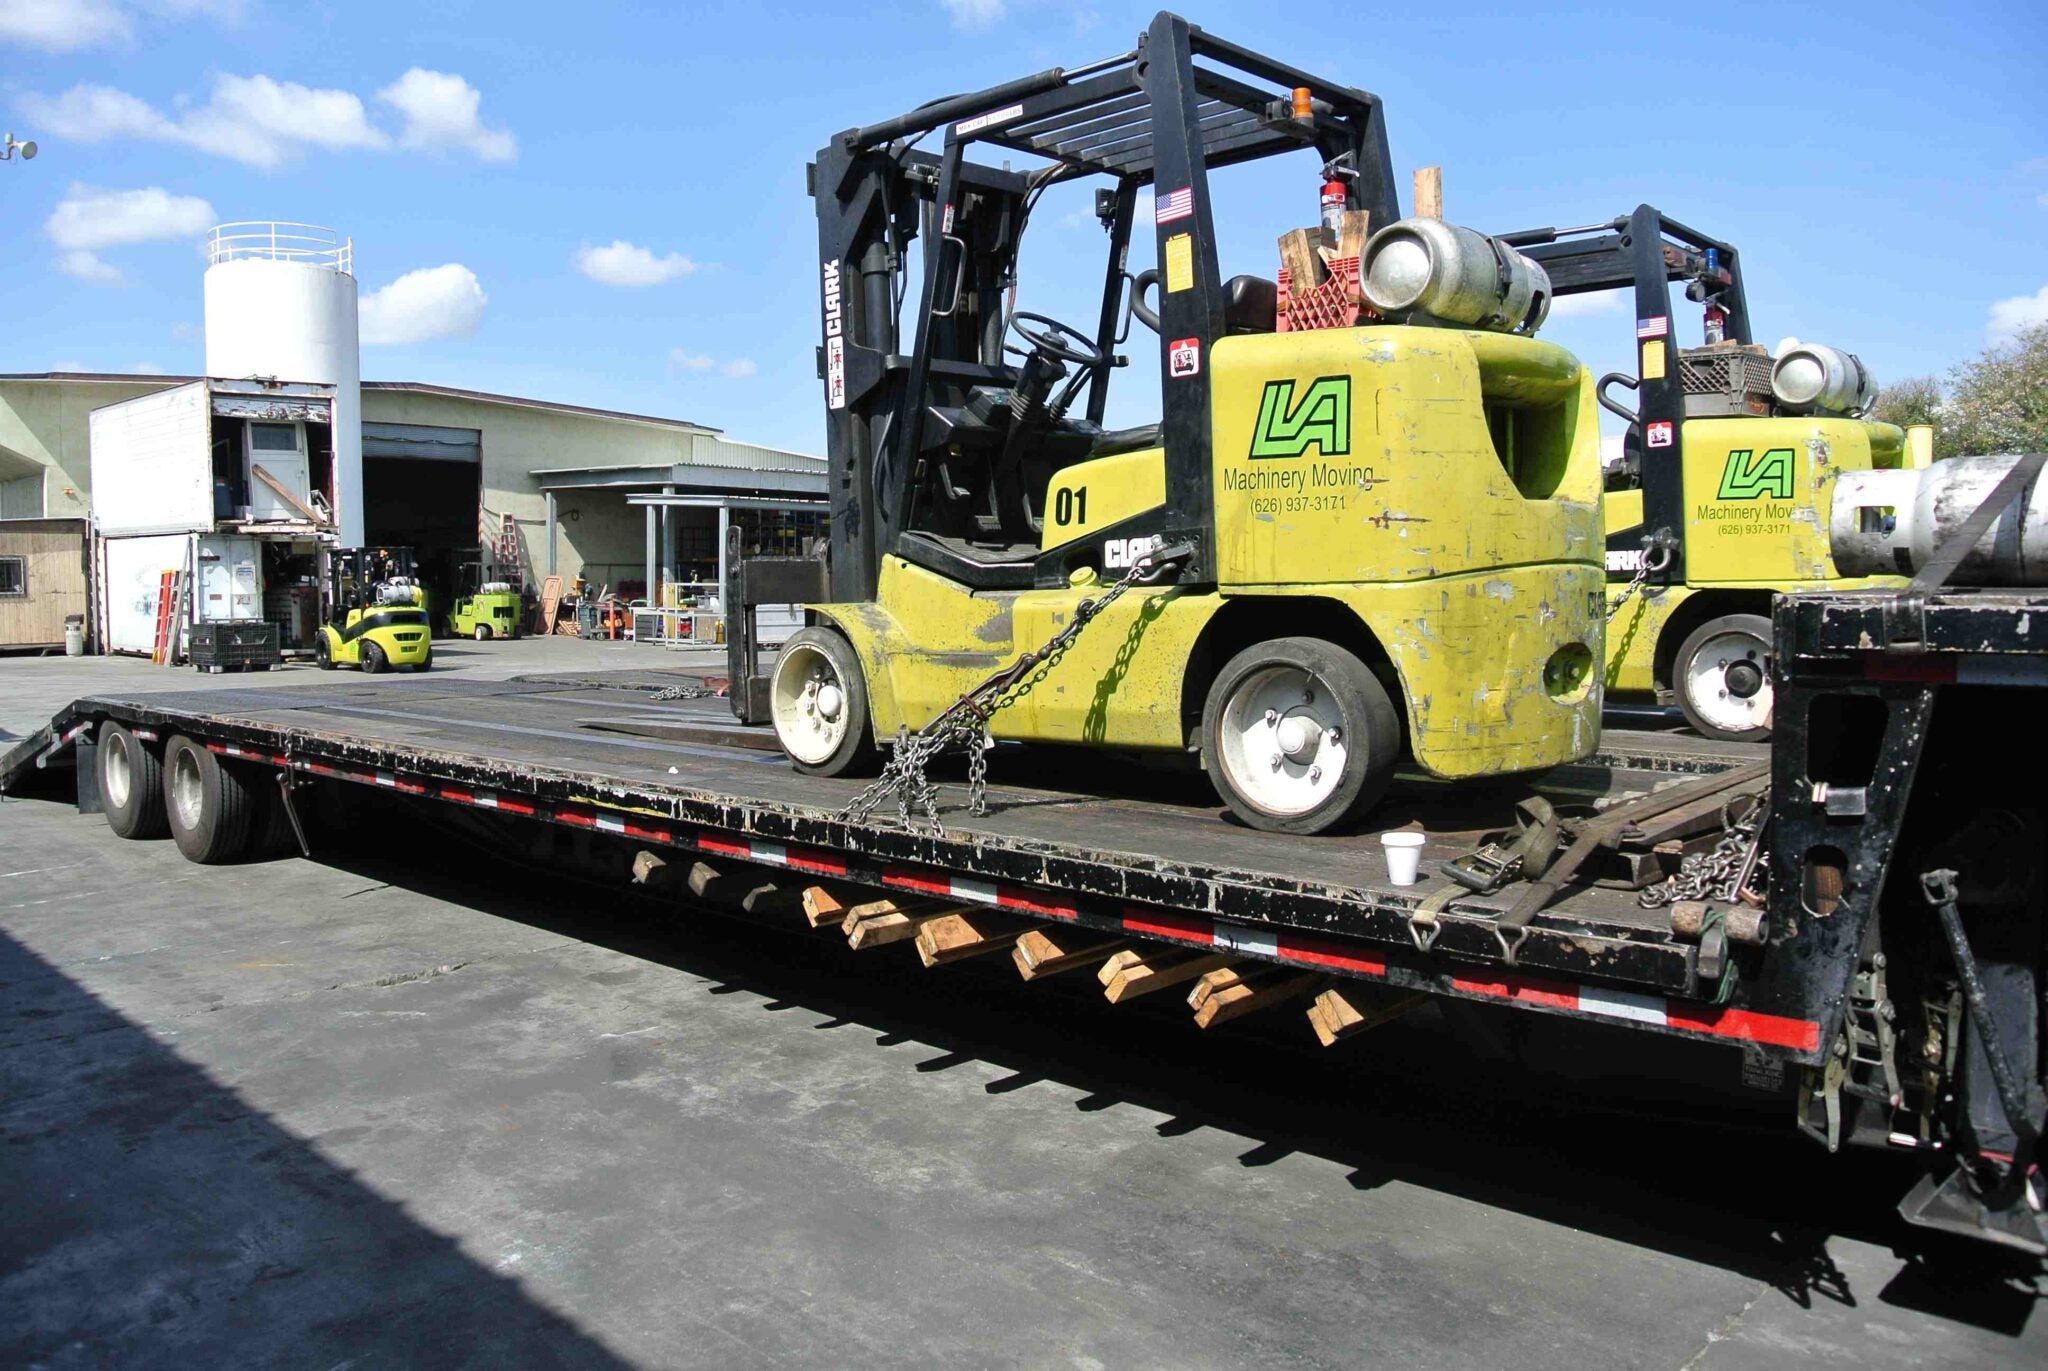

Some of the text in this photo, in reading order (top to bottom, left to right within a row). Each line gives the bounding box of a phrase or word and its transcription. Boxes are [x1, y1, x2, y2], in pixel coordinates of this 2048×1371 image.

[824, 258, 842, 337] CLARK
[1223, 462, 1374, 493] Machinery Moving
[1055, 486, 1087, 526] 01
[1250, 496, 1346, 515] (626) 937-3171
[1697, 504, 1762, 522] Machinery
[1718, 524, 1791, 536] (626) 937-3171
[1605, 549, 1643, 571] ARK
